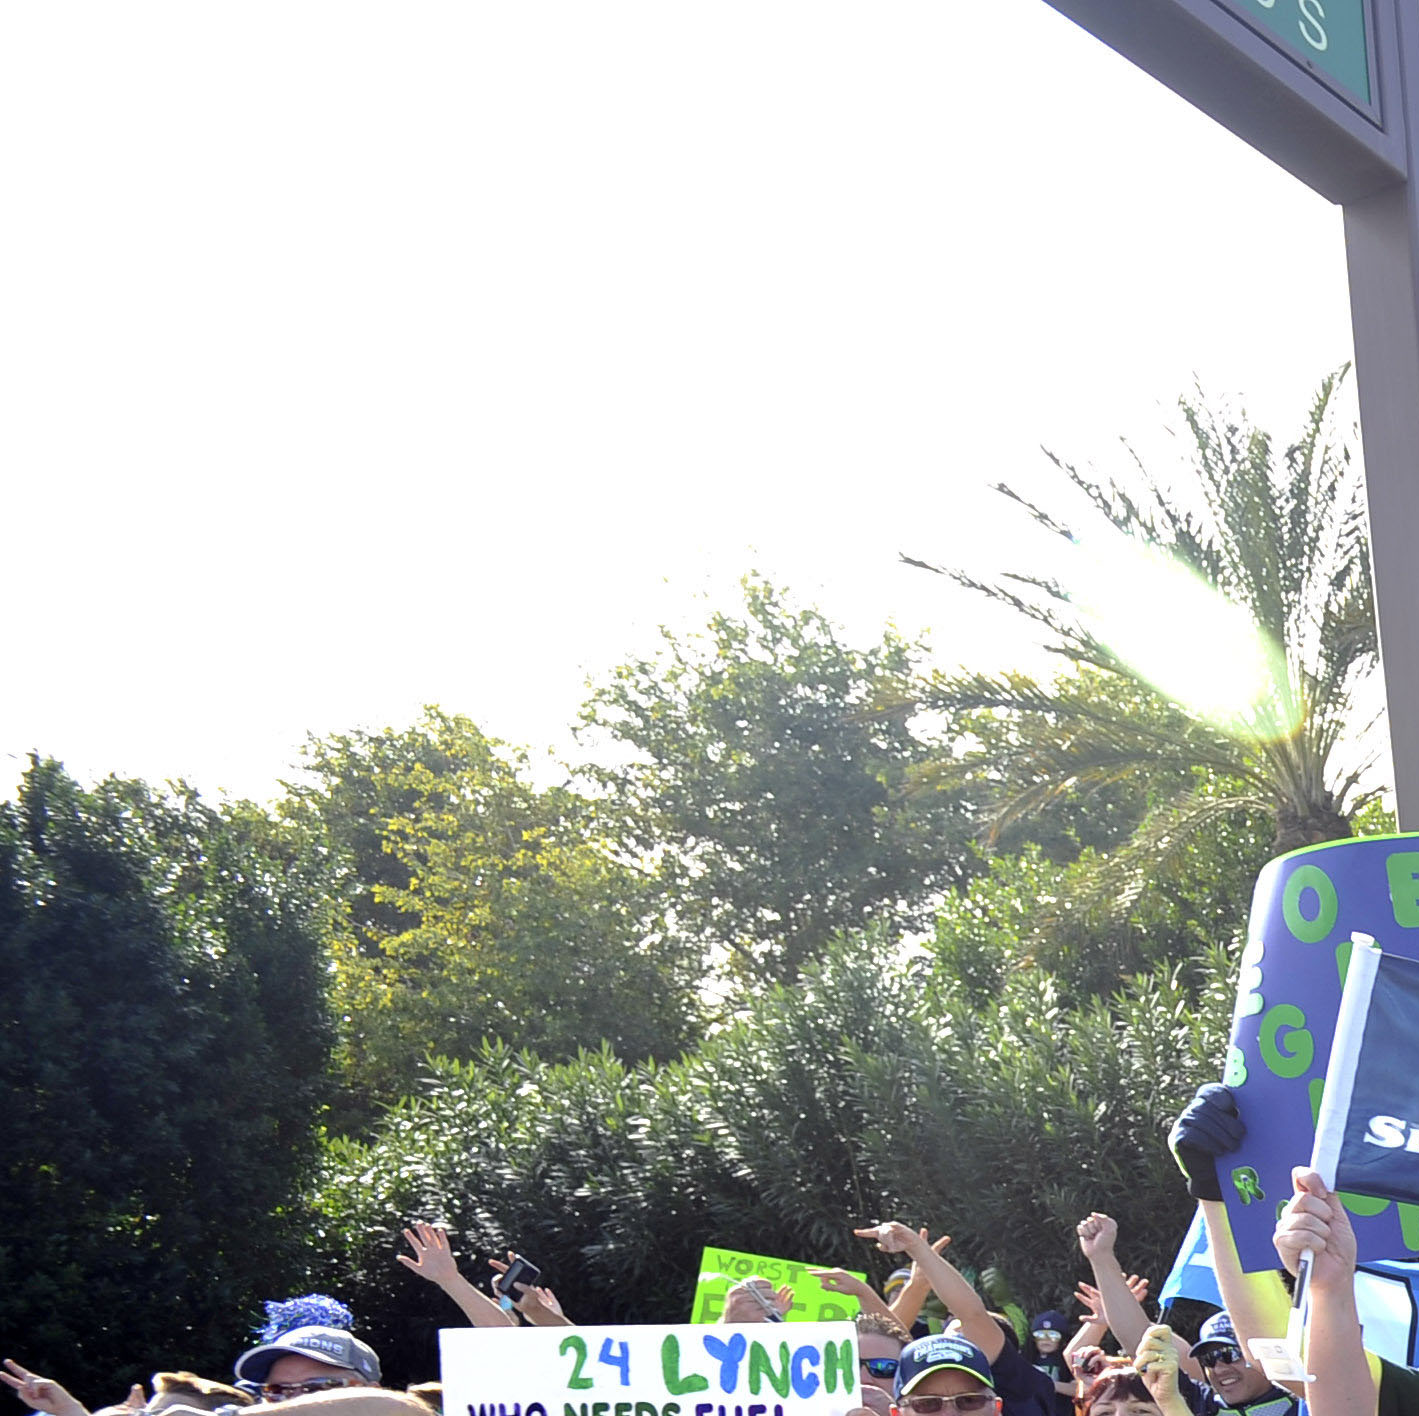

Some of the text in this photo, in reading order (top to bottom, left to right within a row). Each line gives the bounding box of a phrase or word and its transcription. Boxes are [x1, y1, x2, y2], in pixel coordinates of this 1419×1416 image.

[717, 1254, 807, 1284] WORST
[558, 1332, 855, 1399] 24 LYNCH
